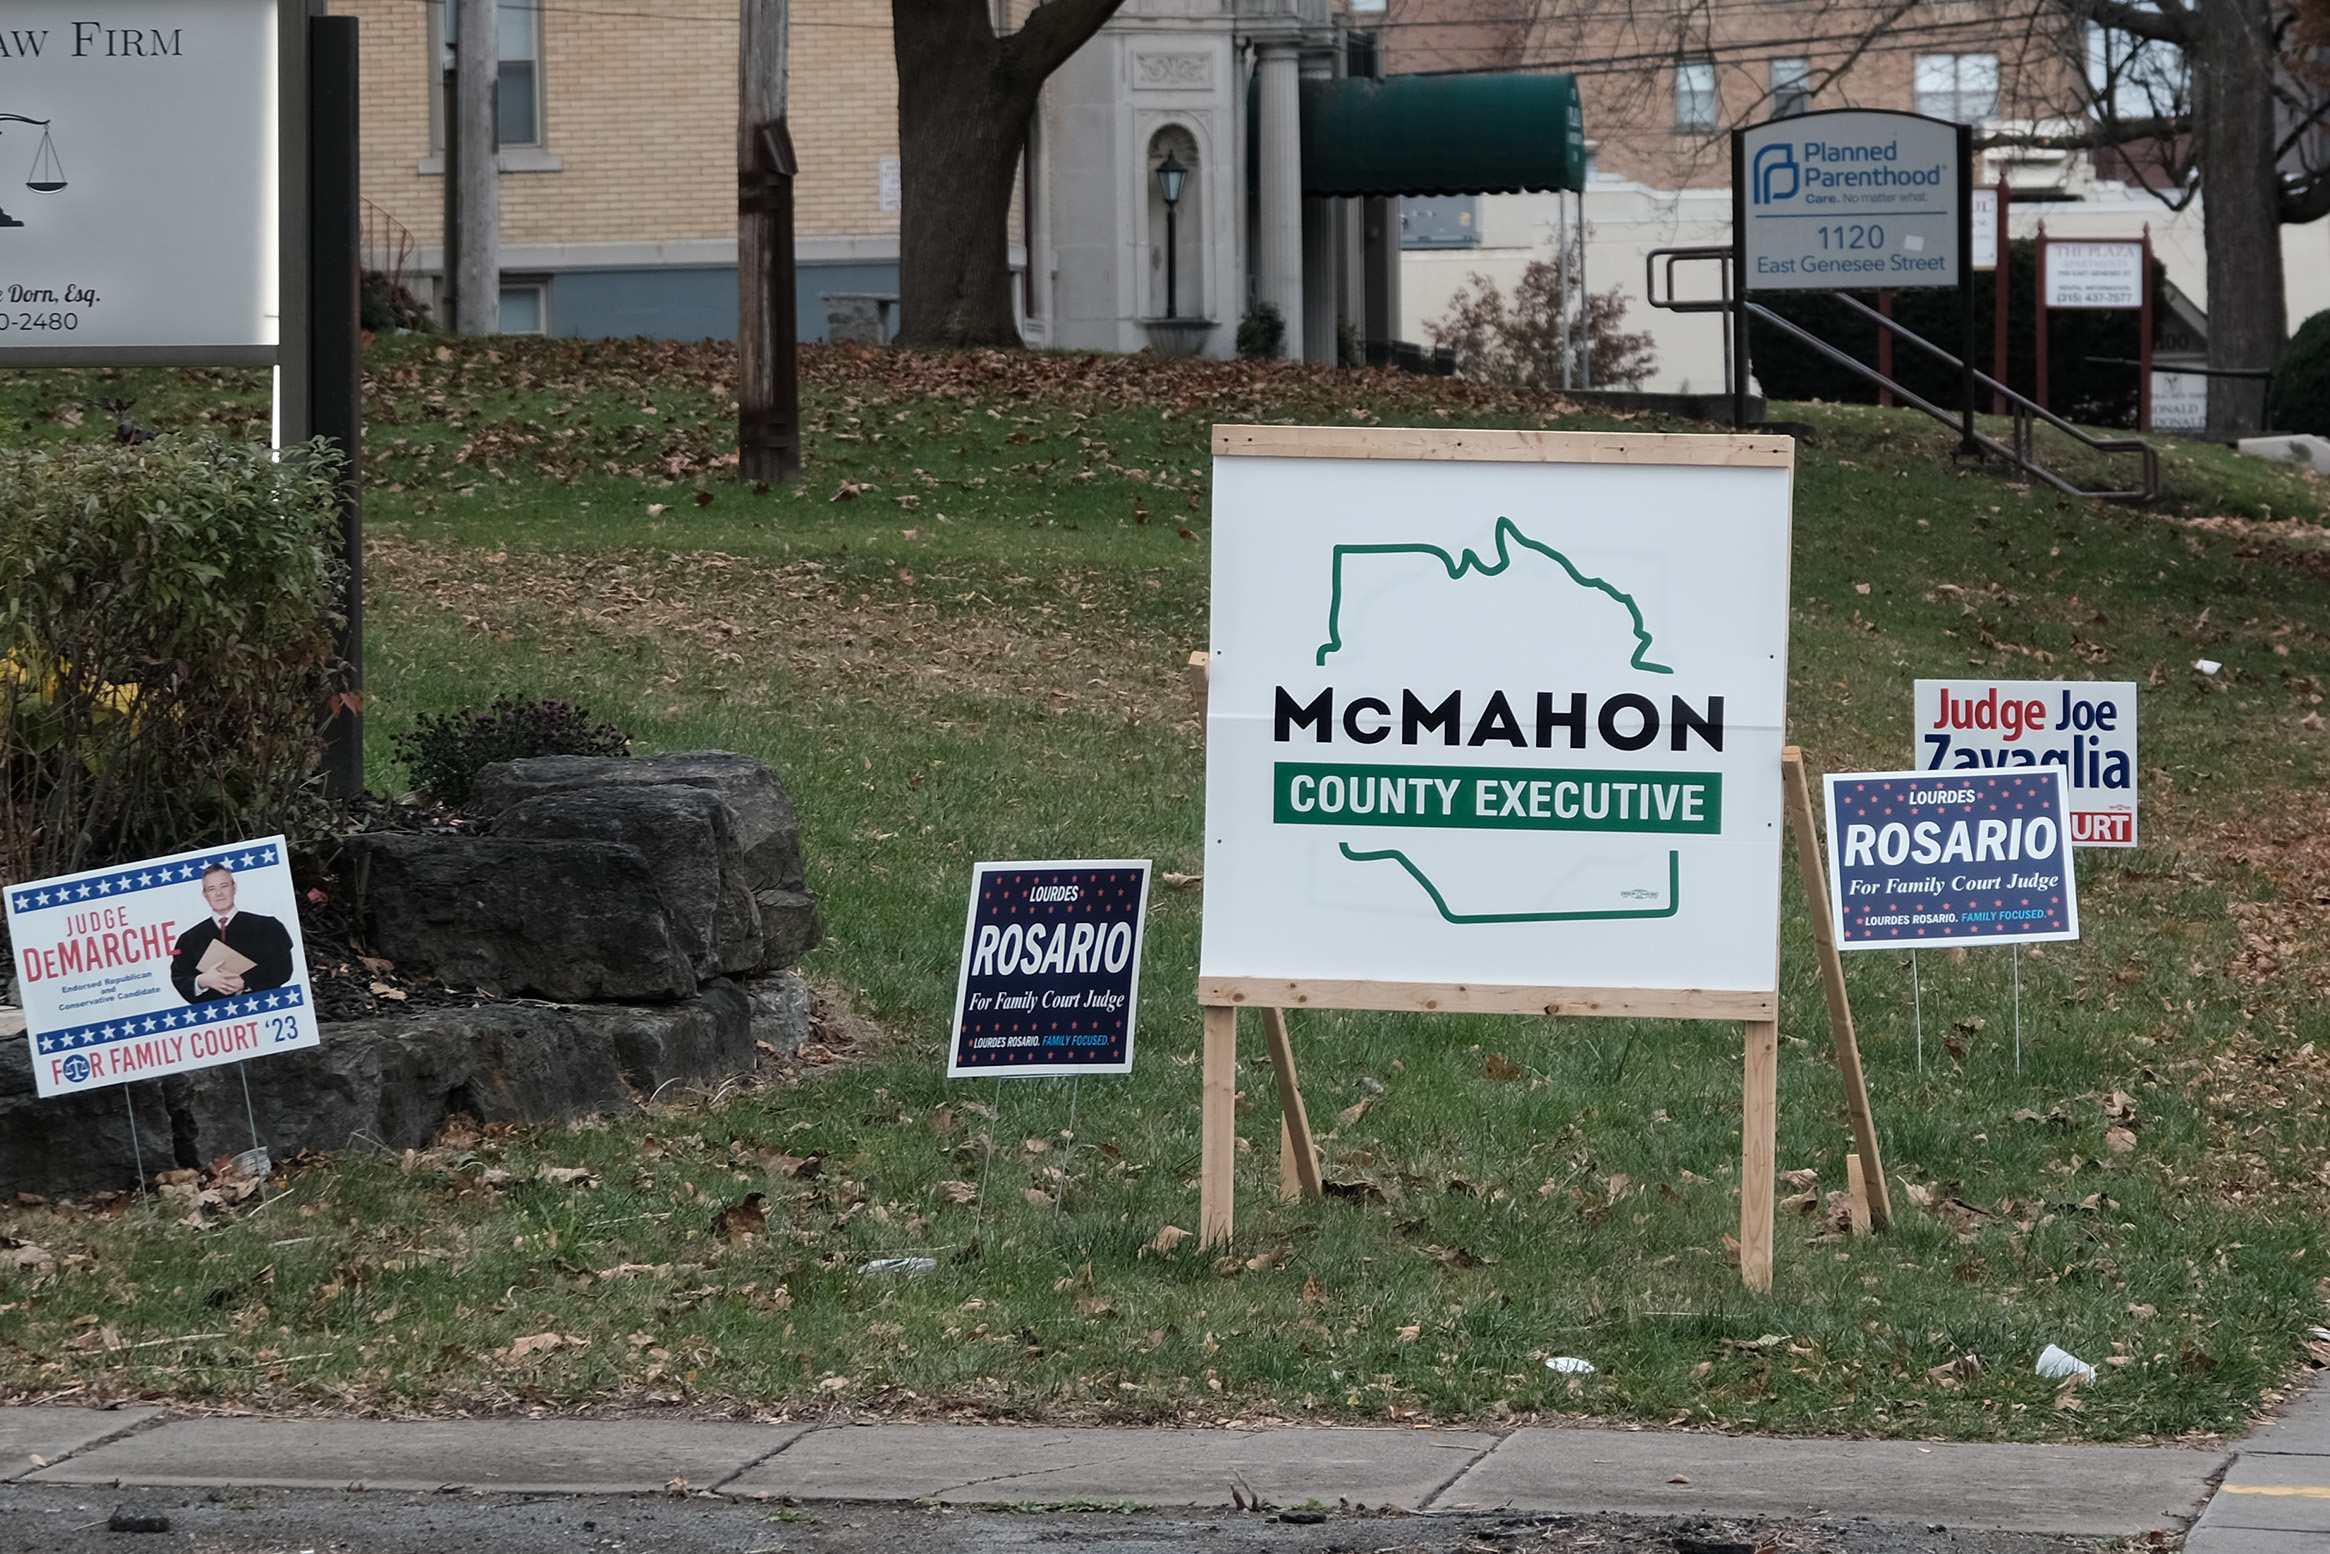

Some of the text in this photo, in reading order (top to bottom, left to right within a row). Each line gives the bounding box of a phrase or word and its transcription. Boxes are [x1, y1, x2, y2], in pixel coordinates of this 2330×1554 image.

[71, 21, 183, 57] FIRM
[1805, 140, 1897, 162] Planned
[1805, 165, 1941, 187] Parenthood
[1806, 194, 1840, 204] Care.
[1843, 193, 1860, 203] No
[1862, 193, 1898, 203] matter
[1818, 225, 1885, 250] 1120
[2056, 245, 2136, 257] THE PLAZA
[1757, 254, 1946, 273] East Genesee Street
[8, 284, 59, 304] Dorn,
[64, 284, 100, 307] Esq.
[1274, 685, 1725, 753] McMAHON
[1933, 687, 2118, 742] Judge Joe
[1289, 774, 1706, 822] COUNTY EXECUTIVE
[1909, 789, 1976, 805] LOURDES
[1844, 816, 2057, 867] ROSARIO
[1029, 885, 1079, 902] LOURDES
[1849, 872, 2059, 896] For Family Court Judge
[66, 905, 130, 938] JUDGE
[1865, 909, 2047, 927] LOURDES ROSARIO. FAMILY FOCUSED.
[971, 921, 1132, 976] ROSARIO
[61, 970, 153, 994] Endorsed Republican
[101, 986, 117, 995] and
[58, 985, 161, 1012] Conservative Candidate
[968, 989, 1125, 1014] For Family Court Judge
[110, 1036, 184, 1075] FAMILY
[190, 1021, 259, 1059] COURT
[973, 1034, 1110, 1049] LOURDES ROSARIO. FAMILY FOCUSED.
